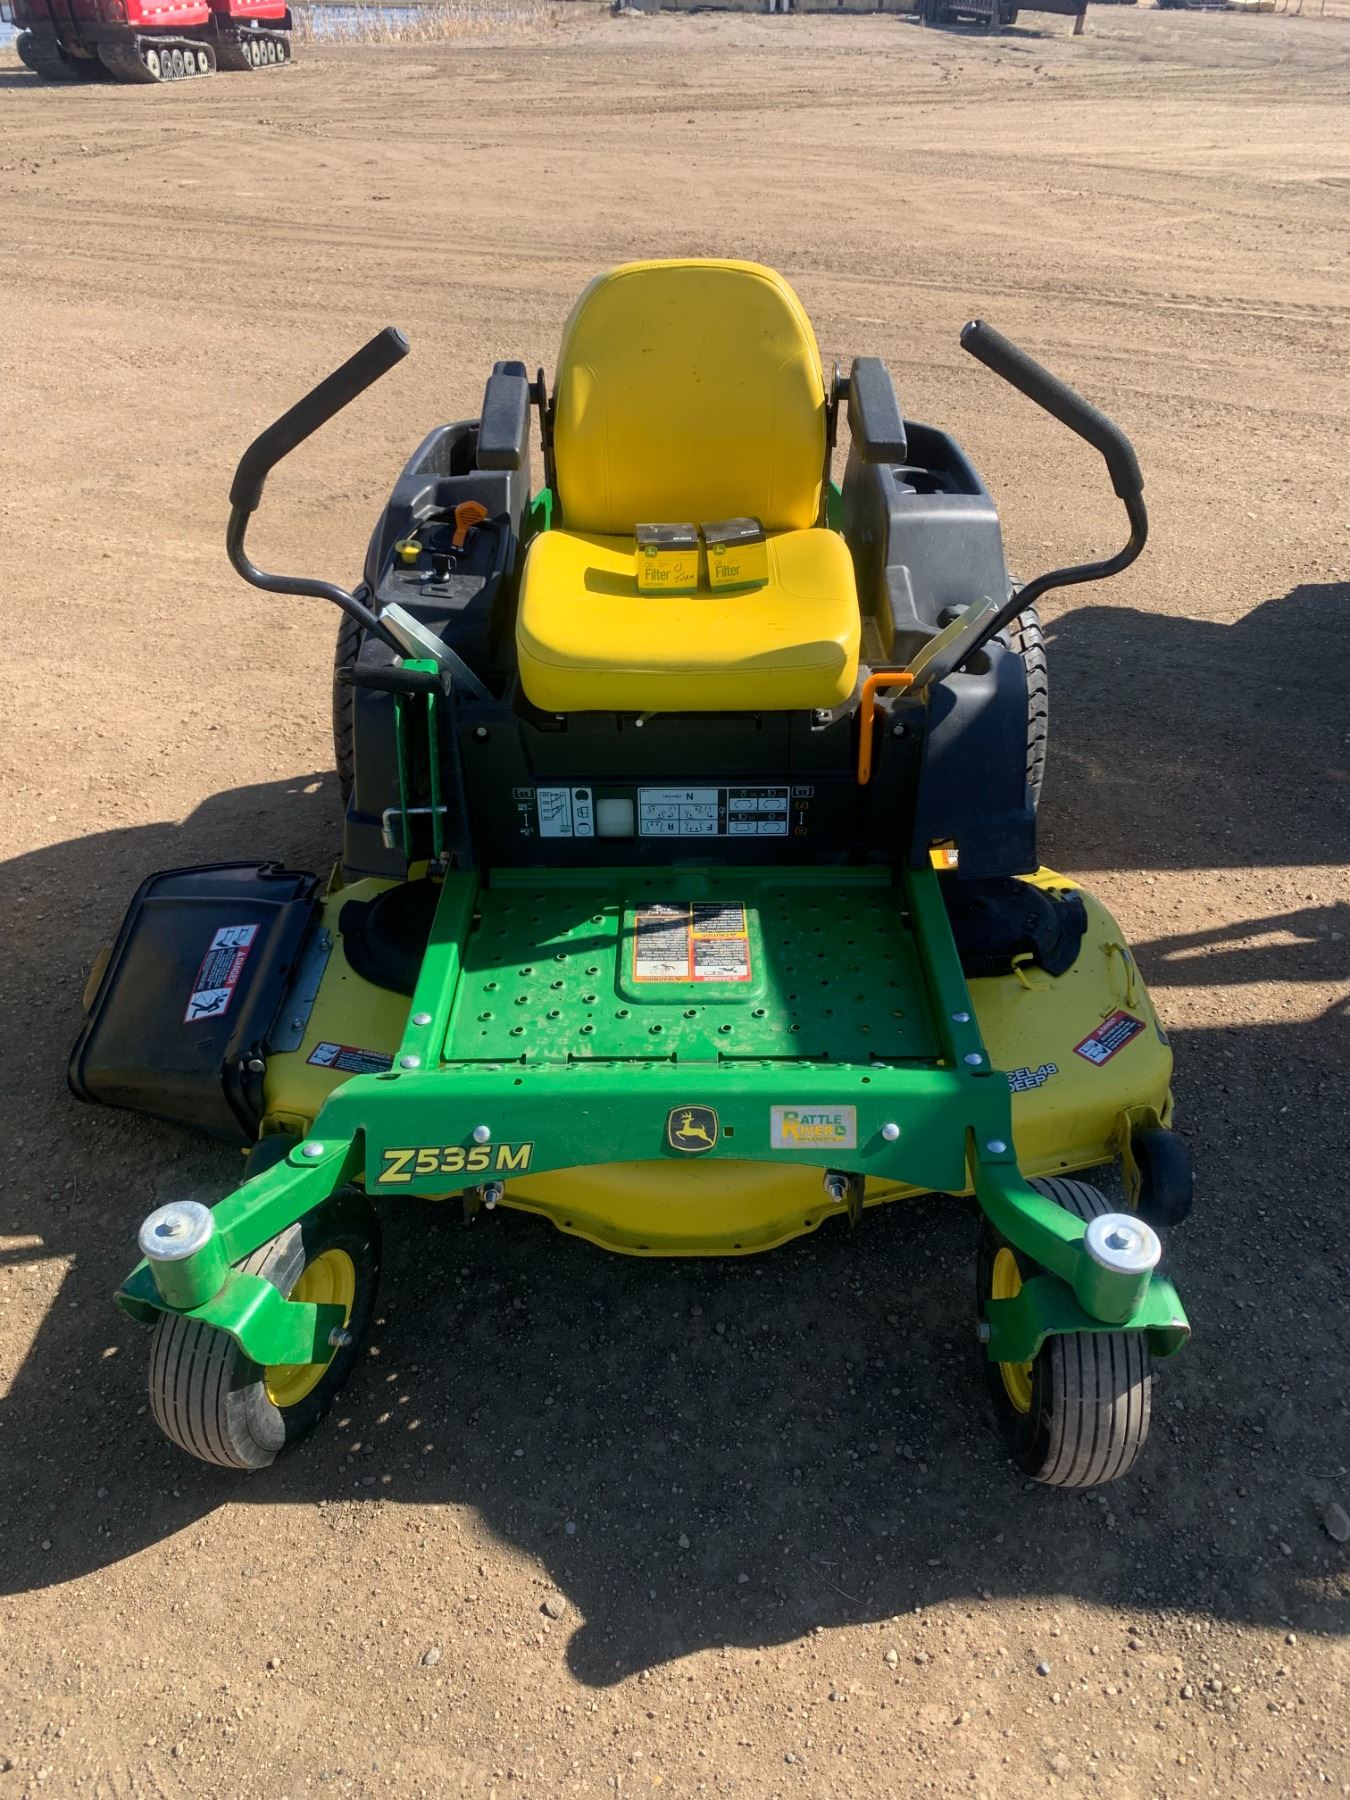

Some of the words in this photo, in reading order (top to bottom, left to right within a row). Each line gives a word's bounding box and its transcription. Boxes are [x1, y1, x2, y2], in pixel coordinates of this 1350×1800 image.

[645, 568, 671, 581] Filter
[715, 565, 741, 578] Filter
[685, 792, 694, 800] N
[781, 1120, 834, 1142] RIVER
